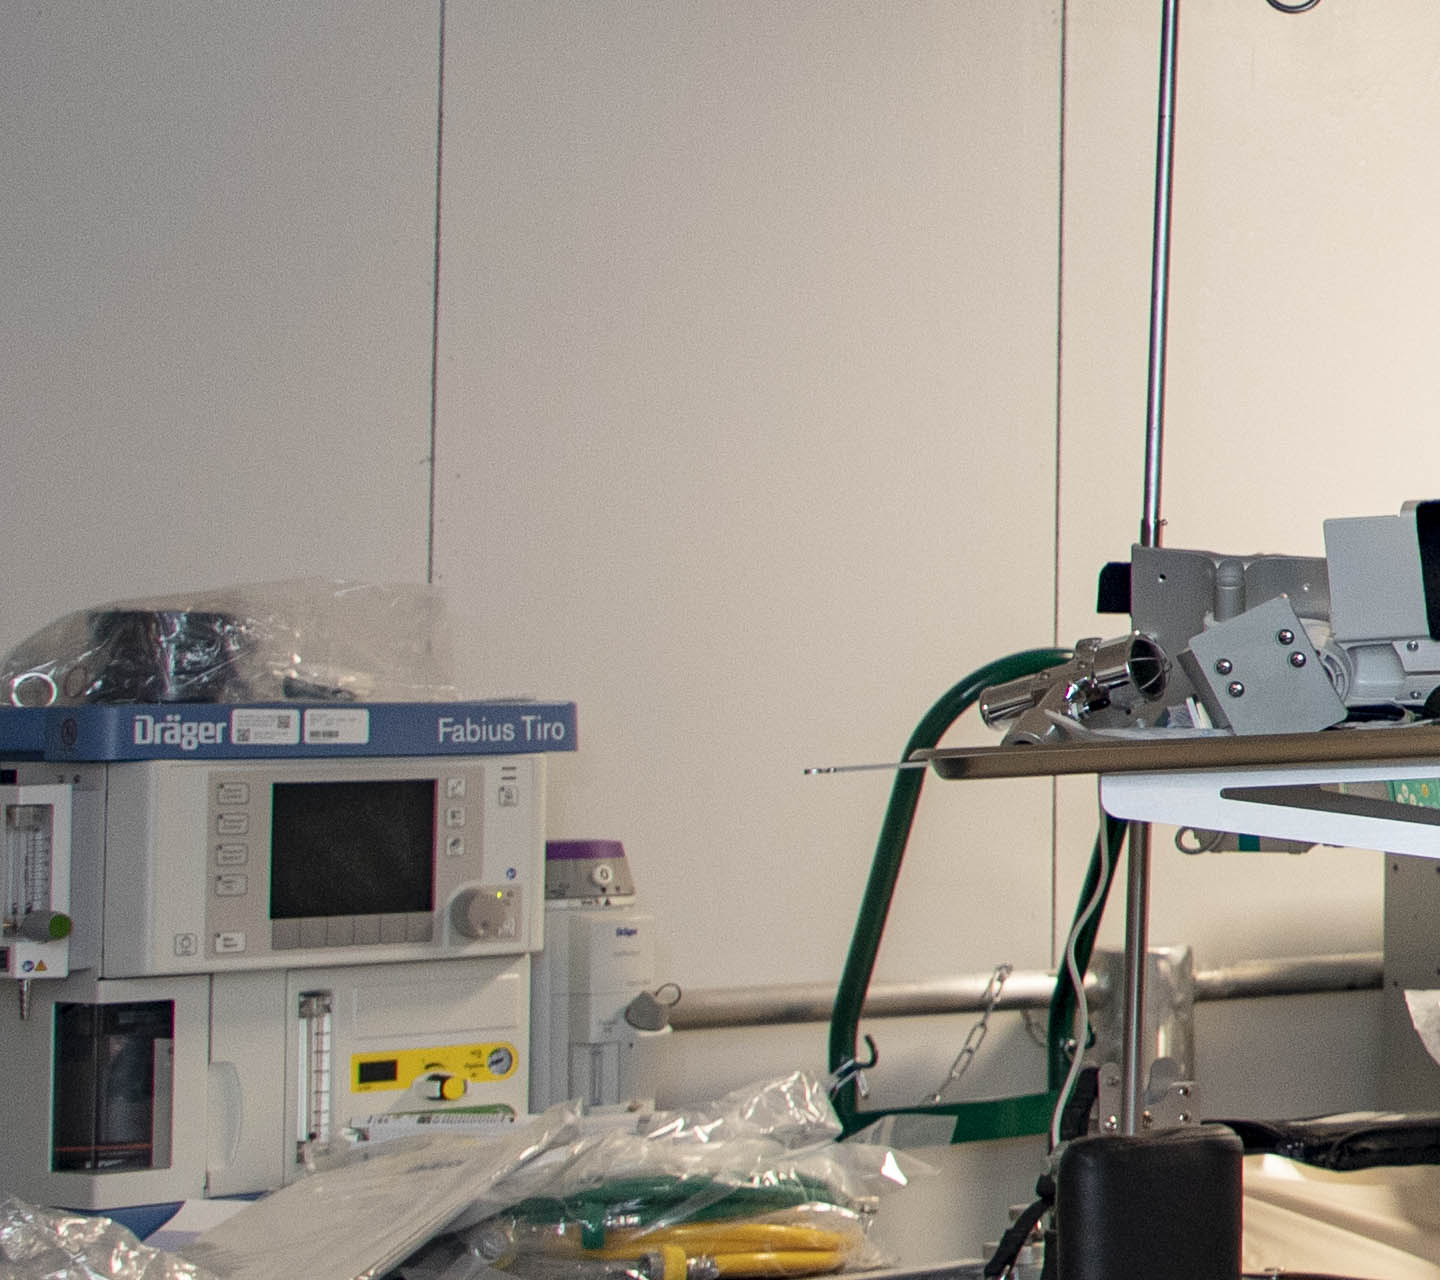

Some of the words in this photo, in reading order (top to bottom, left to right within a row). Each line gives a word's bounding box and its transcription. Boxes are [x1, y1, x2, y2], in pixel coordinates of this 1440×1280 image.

[133, 713, 228, 750] Dräger
[437, 717, 515, 743] Fabius
[521, 715, 566, 741] Tiro
